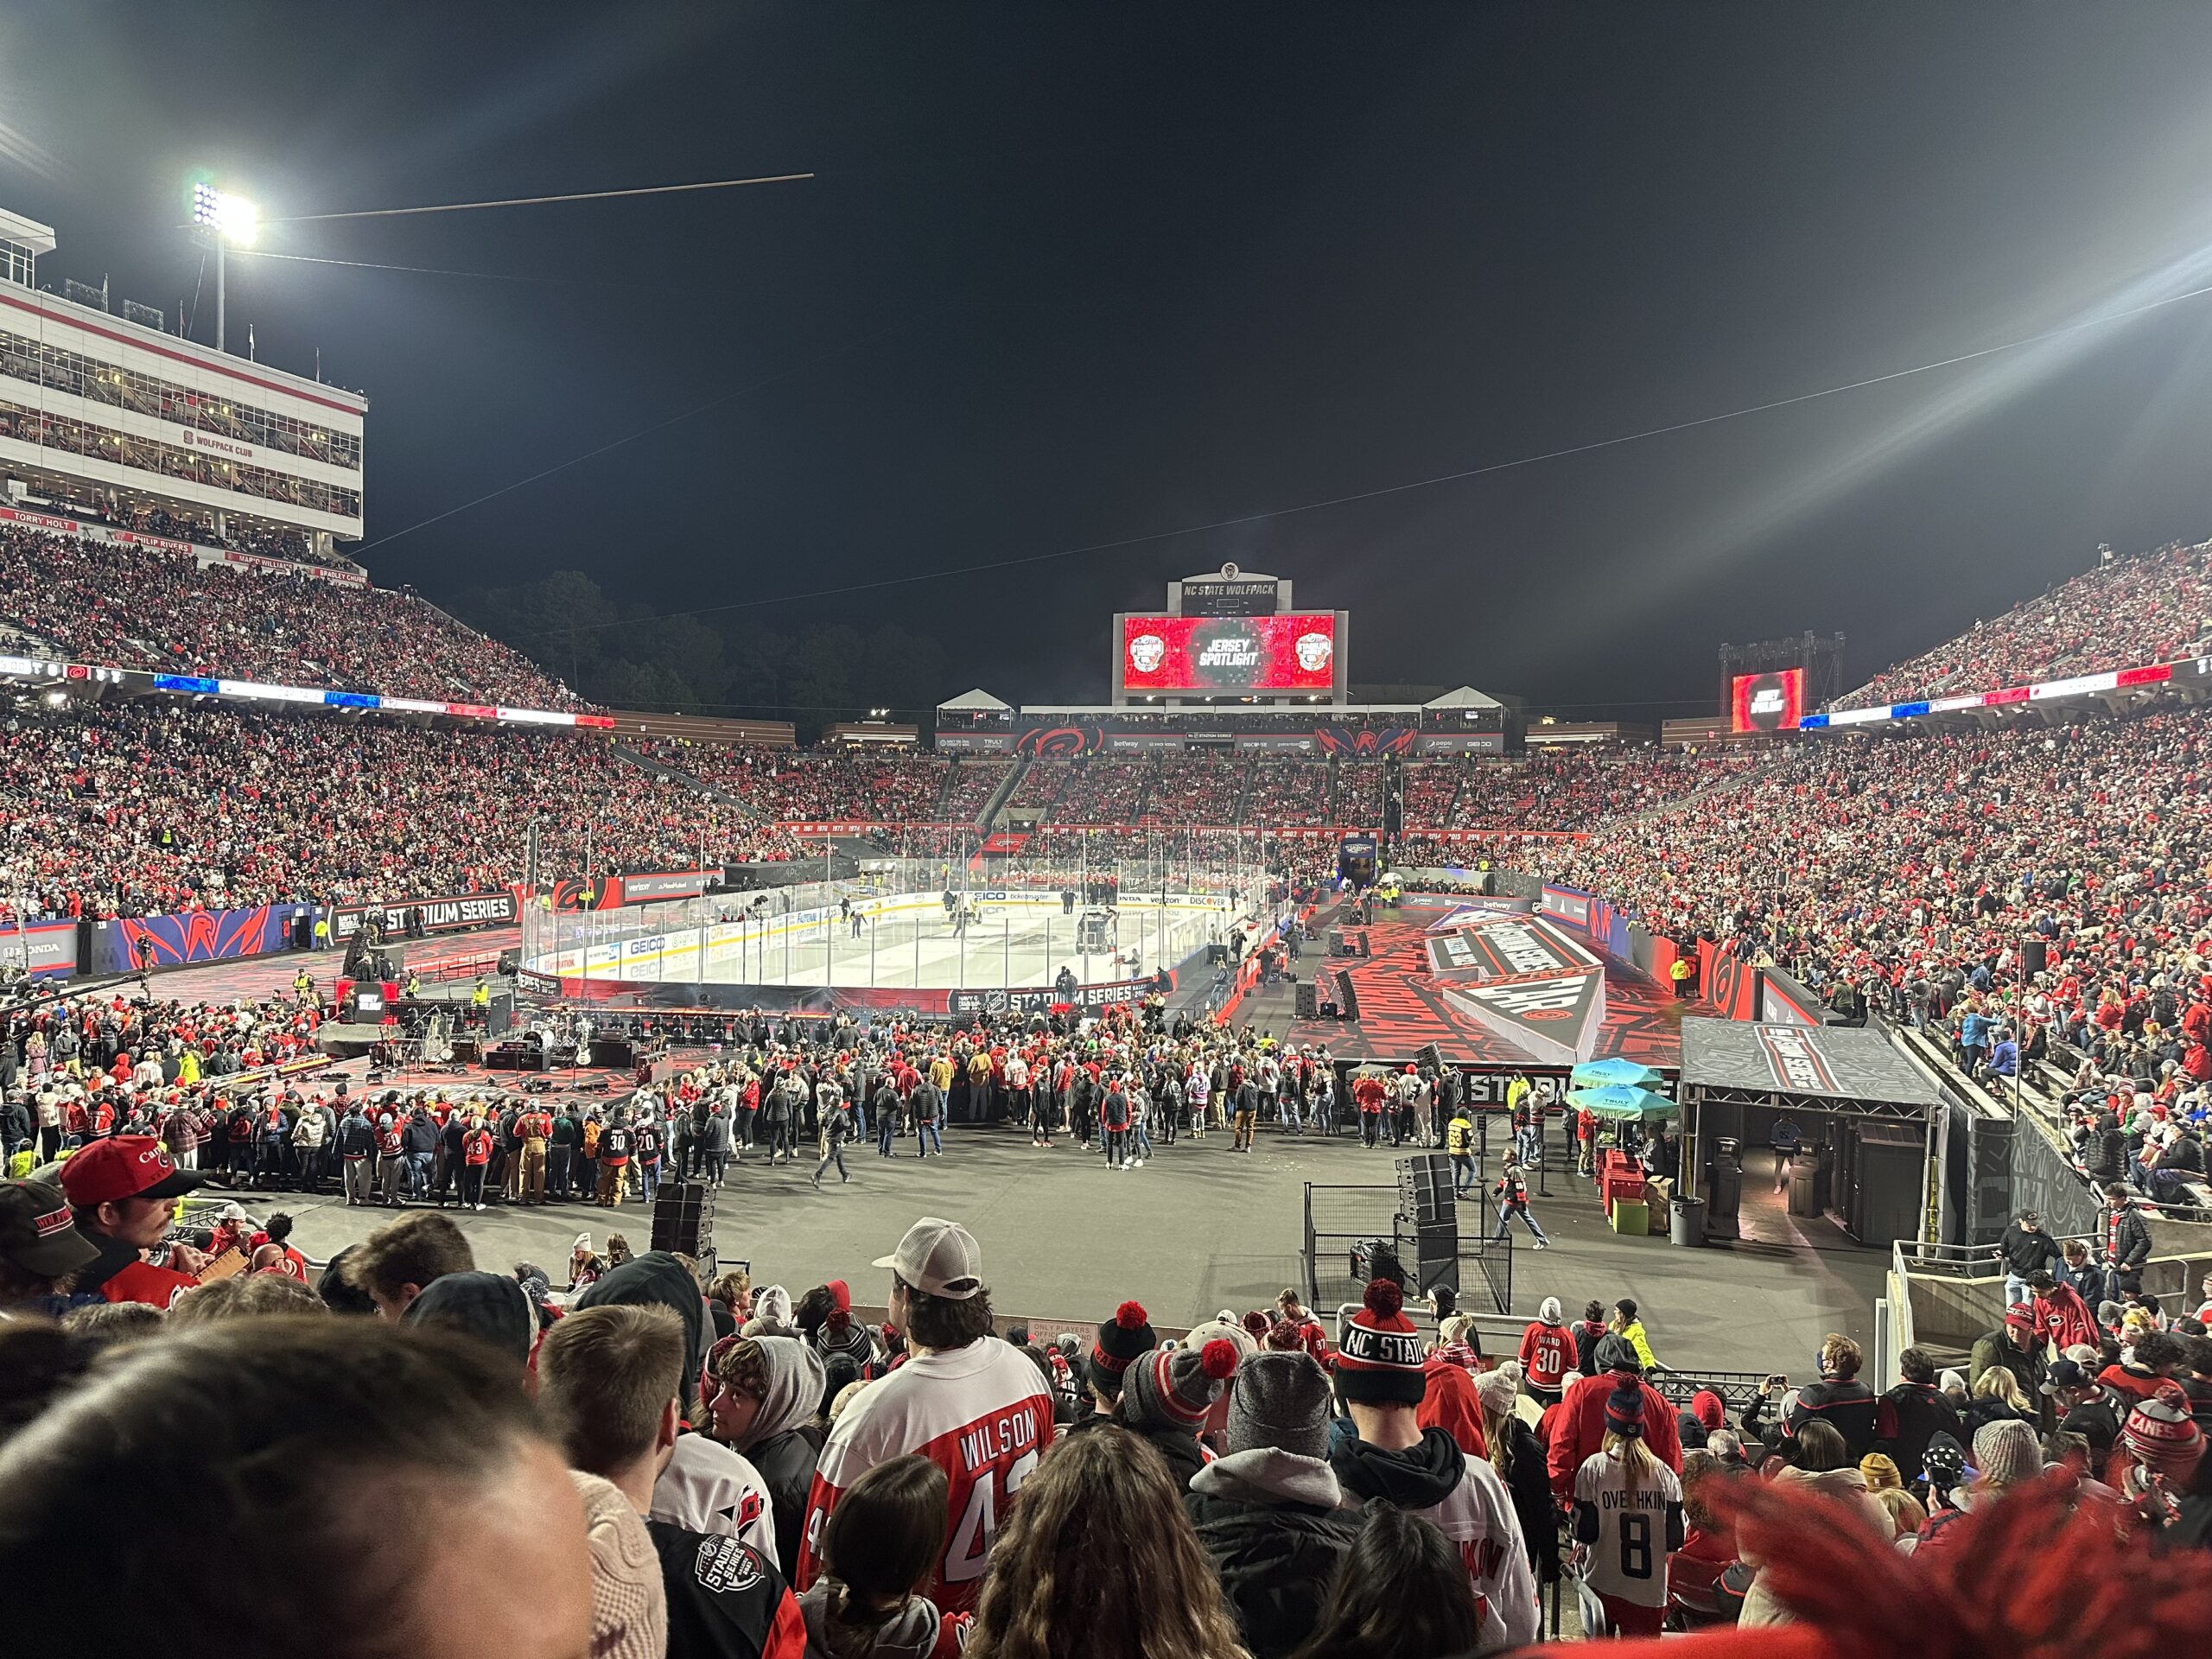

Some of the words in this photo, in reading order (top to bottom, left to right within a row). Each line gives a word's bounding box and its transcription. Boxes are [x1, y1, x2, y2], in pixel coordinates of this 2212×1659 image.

[197, 436, 233, 453] WOLFPACK
[235, 447, 252, 457] CLUB
[14, 512, 43, 524] TORRY
[46, 518, 70, 529] HOLT
[132, 535, 158, 547] PHILIP
[160, 538, 188, 552] RIVERS
[320, 569, 345, 580] BRADLEY
[346, 575, 366, 583] CHUBB
[1185, 586, 1197, 595] NC
[1198, 585, 1224, 595] STATE
[1226, 584, 1274, 595] WOLFPACK
[1207, 639, 1250, 652] JERSEY
[1199, 652, 1259, 666] SPOTLIGHT
[1114, 740, 1139, 748] betway
[628, 881, 652, 892] verizon
[970, 892, 1006, 900] EICO
[1150, 896, 1183, 905] verzon
[1190, 897, 1225, 906] DISCOVER
[1484, 900, 1511, 911] betway
[386, 903, 459, 931] STDIUM
[461, 898, 510, 920] SERIES
[631, 937, 664, 955] GEICO
[1010, 991, 1084, 1009] STADIM
[1089, 985, 1132, 1005] SERIES
[385, 1135, 400, 1147] 20
[467, 1140, 483, 1154] 43
[610, 1135, 626, 1151] 30
[638, 1134, 654, 1152] 20
[1448, 1130, 1463, 1147] 63
[36, 1207, 72, 1229] WOLFP
[1315, 1338, 1326, 1351] 87
[1345, 1329, 1373, 1357] NC
[1539, 1335, 1560, 1347] WARD
[1096, 1351, 1126, 1370] CARO
[1536, 1347, 1561, 1374] 30
[2129, 1413, 2175, 1440] CANES
[959, 1407, 1036, 1472] WILSON
[1602, 1491, 1666, 1510] OVEHKIN
[1619, 1512, 1652, 1580] 8
[705, 1537, 740, 1587] STADIUM
[722, 1547, 746, 1580] SERIES
